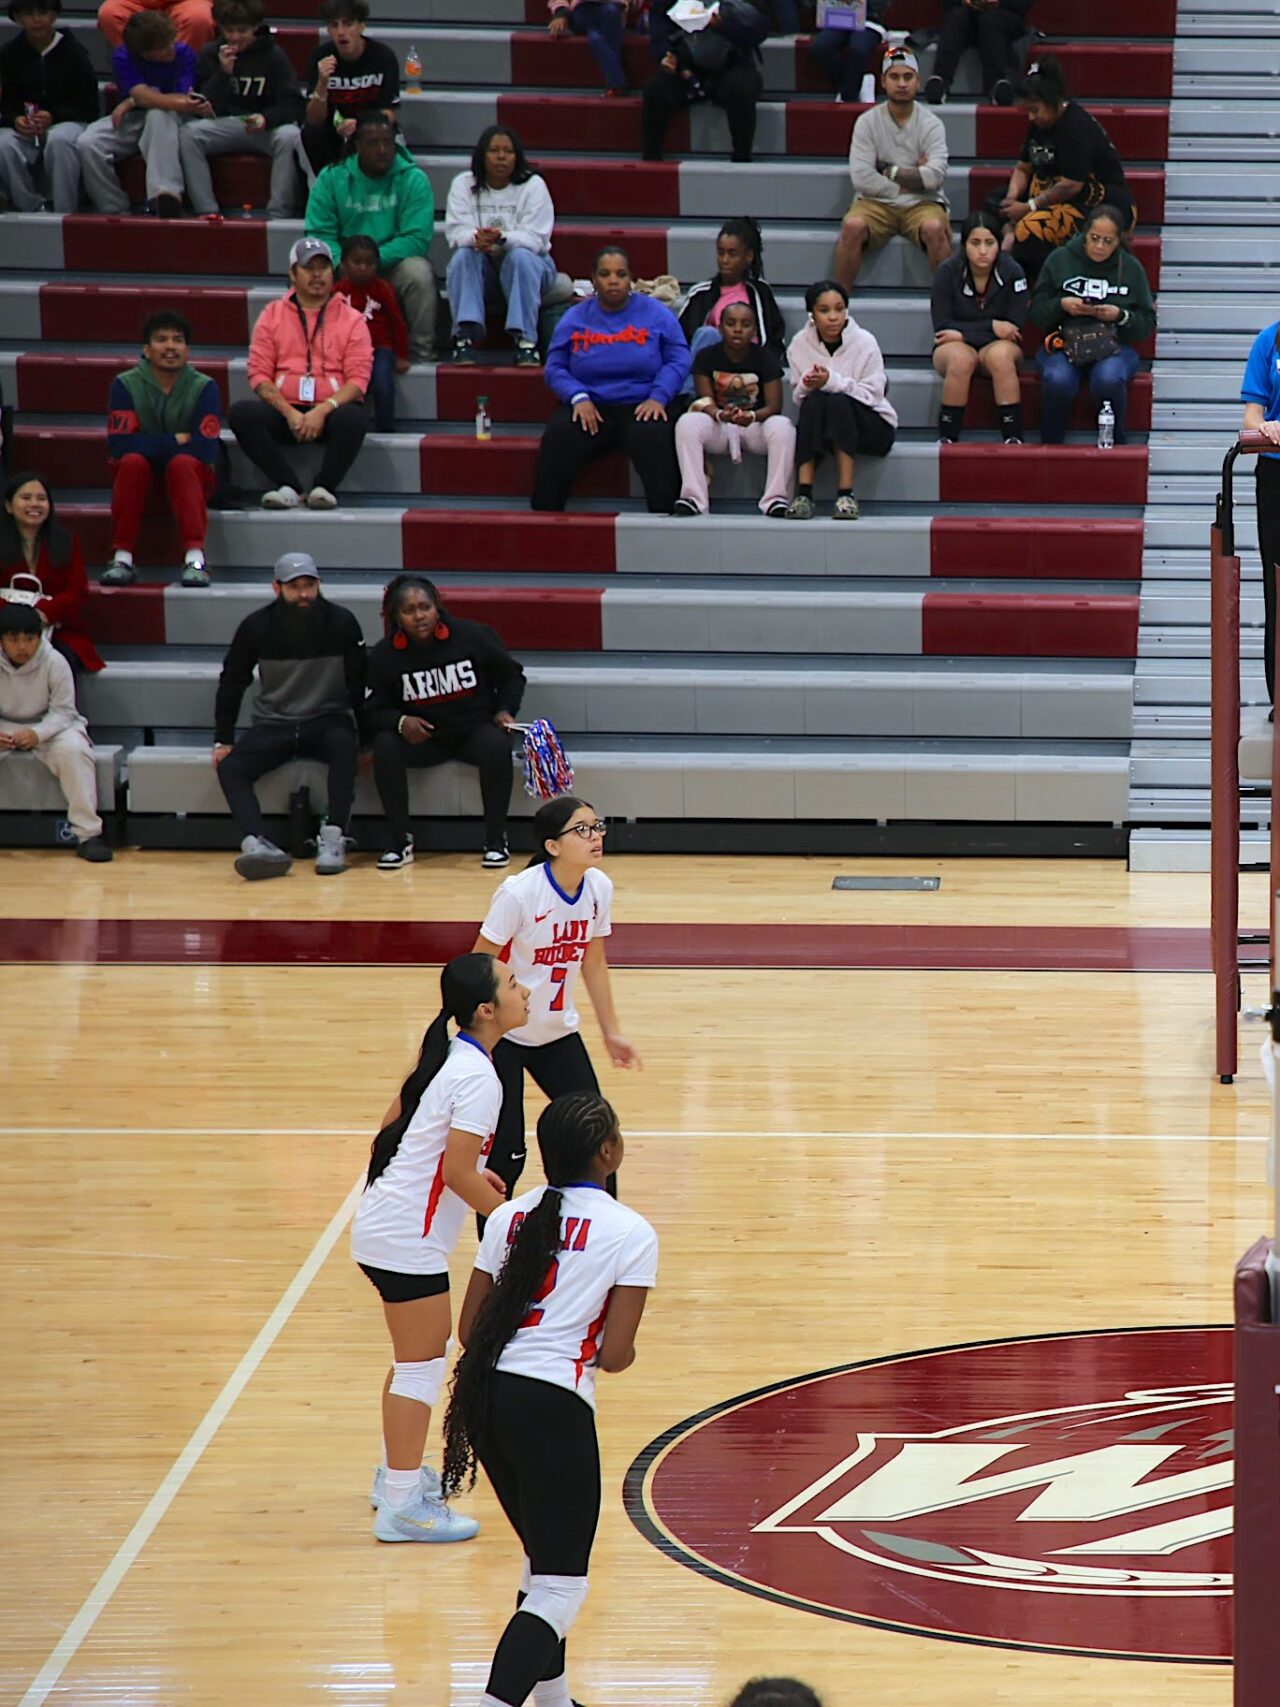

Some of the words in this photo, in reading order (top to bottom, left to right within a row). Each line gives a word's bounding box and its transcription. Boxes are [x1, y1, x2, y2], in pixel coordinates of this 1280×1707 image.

[401, 659, 478, 702] ARMS
[552, 919, 589, 944] LADY
[549, 967, 568, 1011] 7
